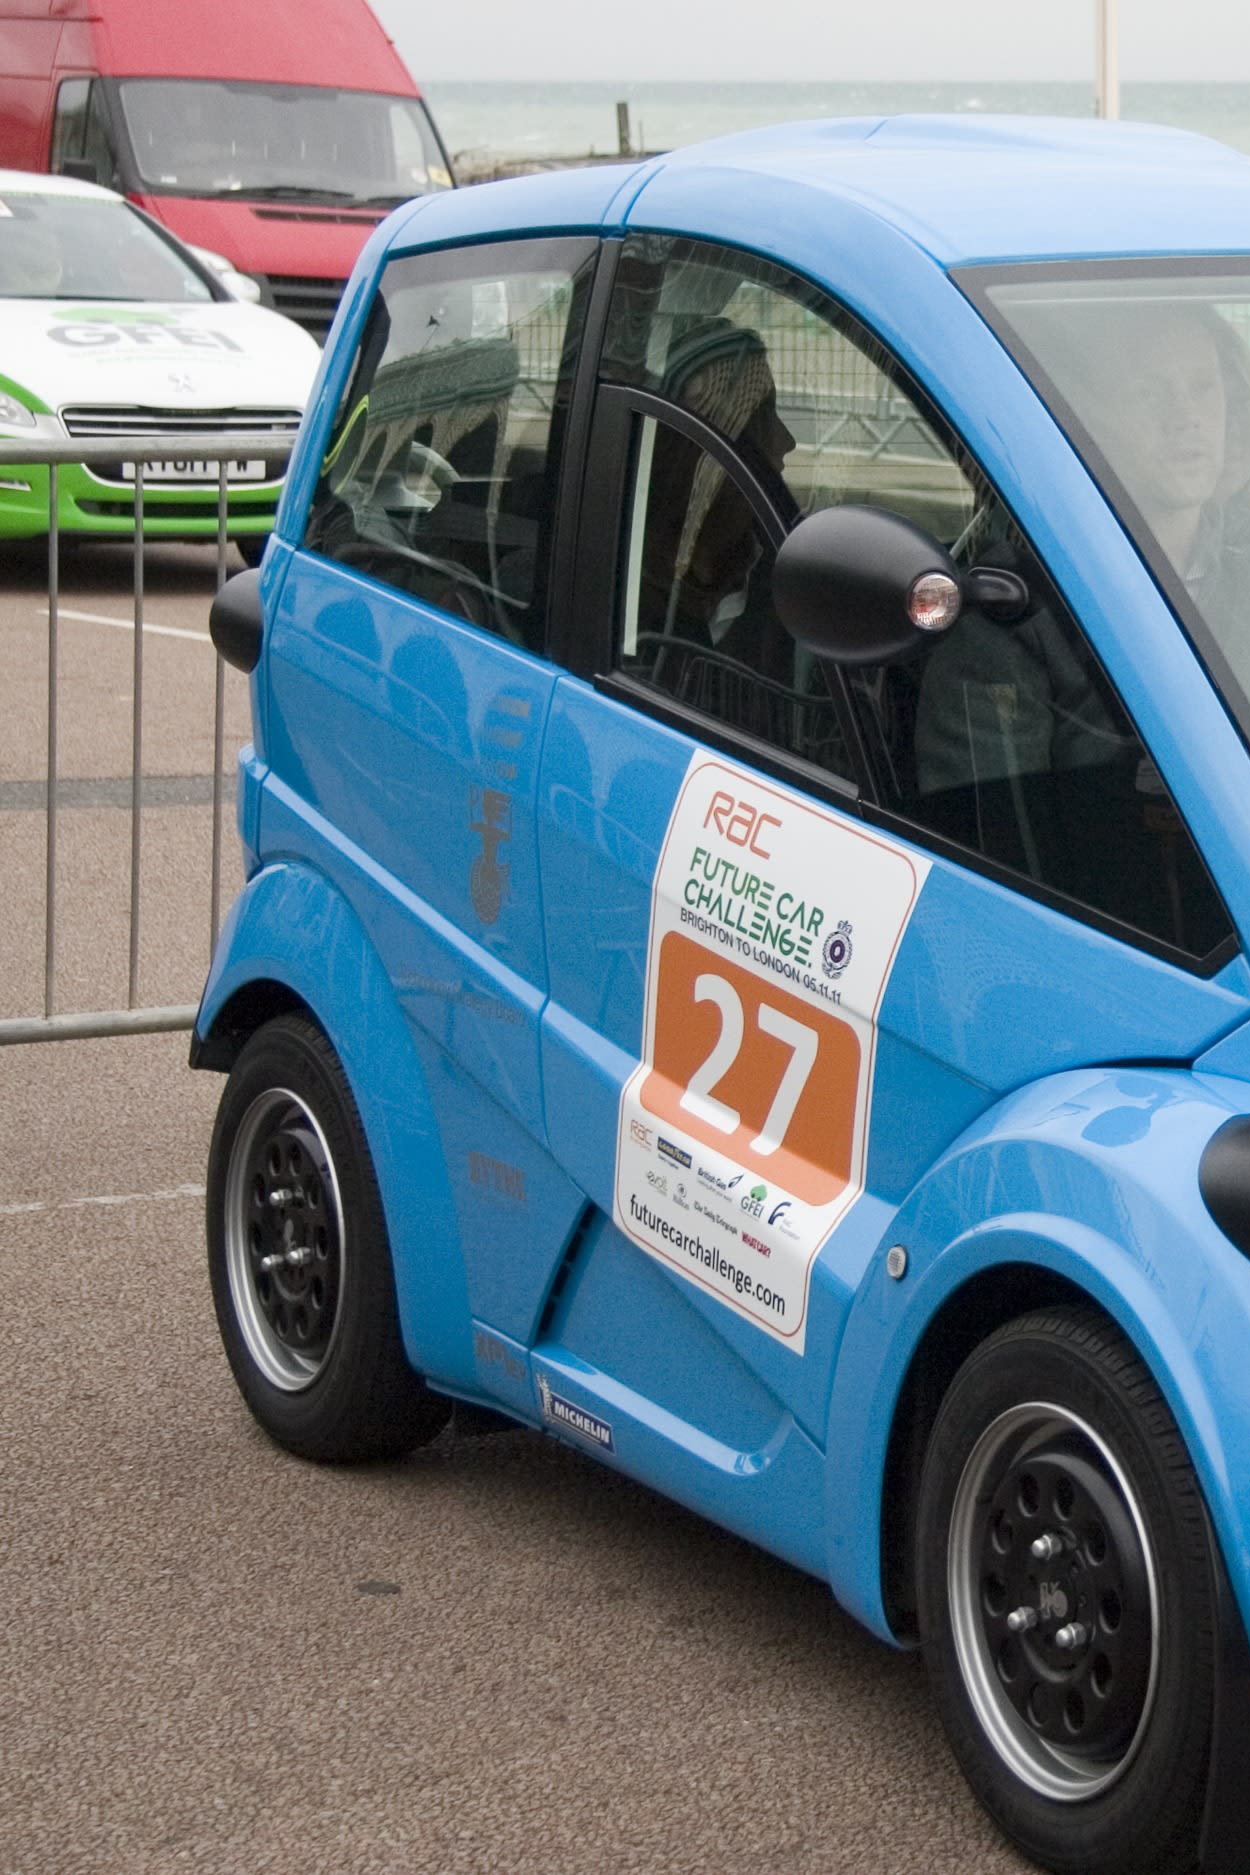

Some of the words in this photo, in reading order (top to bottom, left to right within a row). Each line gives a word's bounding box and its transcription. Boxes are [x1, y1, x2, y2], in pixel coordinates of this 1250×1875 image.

[47, 324, 244, 352] GFEI
[690, 847, 775, 911] FUTURE
[776, 892, 824, 936] CAR
[680, 908, 735, 947] BRIGHTON
[736, 937, 751, 957] TO
[753, 949, 801, 983] LONDON
[803, 973, 841, 1005] 05.11.11
[680, 973, 819, 1156] 27
[740, 1196, 765, 1218] GFEI
[630, 1194, 785, 1316] futurecarchallenge.com
[554, 1401, 610, 1444] MICHELIN
